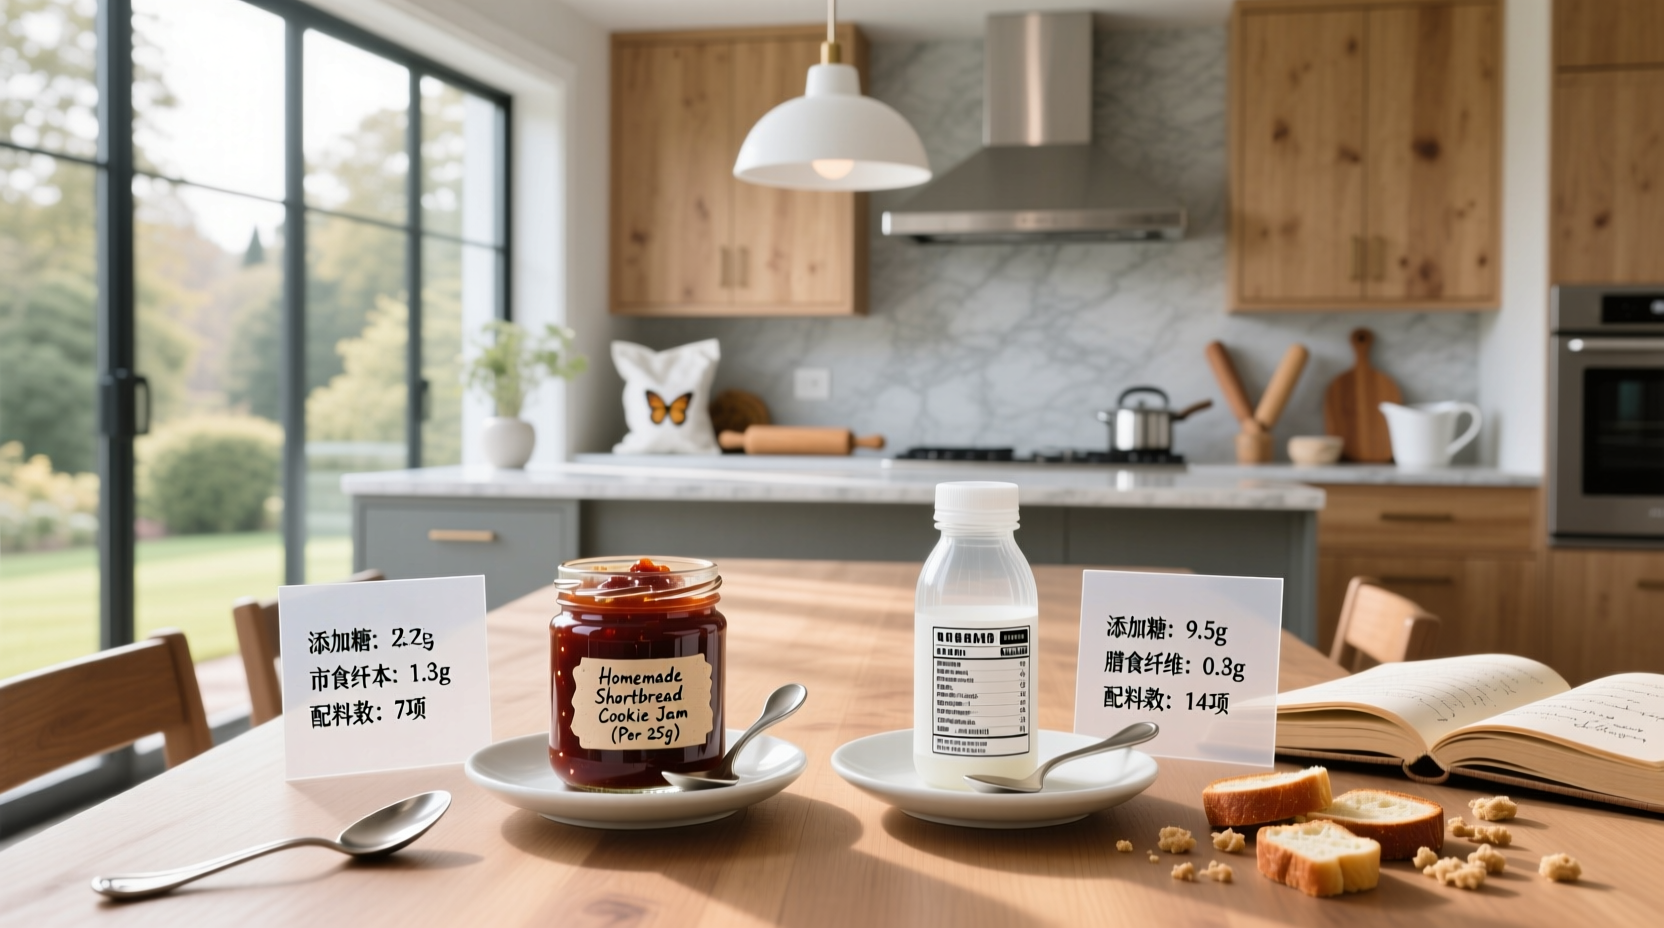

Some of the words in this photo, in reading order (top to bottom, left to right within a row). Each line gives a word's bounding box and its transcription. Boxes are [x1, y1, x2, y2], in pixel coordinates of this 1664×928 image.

[1186, 620, 1228, 646] 9.5g
[410, 661, 451, 686] 1.3g
[599, 666, 683, 686] Homemade
[595, 685, 683, 705] Shortbread
[1186, 691, 1230, 715] 14项
[394, 696, 427, 720] 7项
[598, 707, 649, 723] Cookie
[656, 706, 688, 722] Jam
[611, 725, 642, 744] (Per
[647, 723, 680, 746] 25g)
